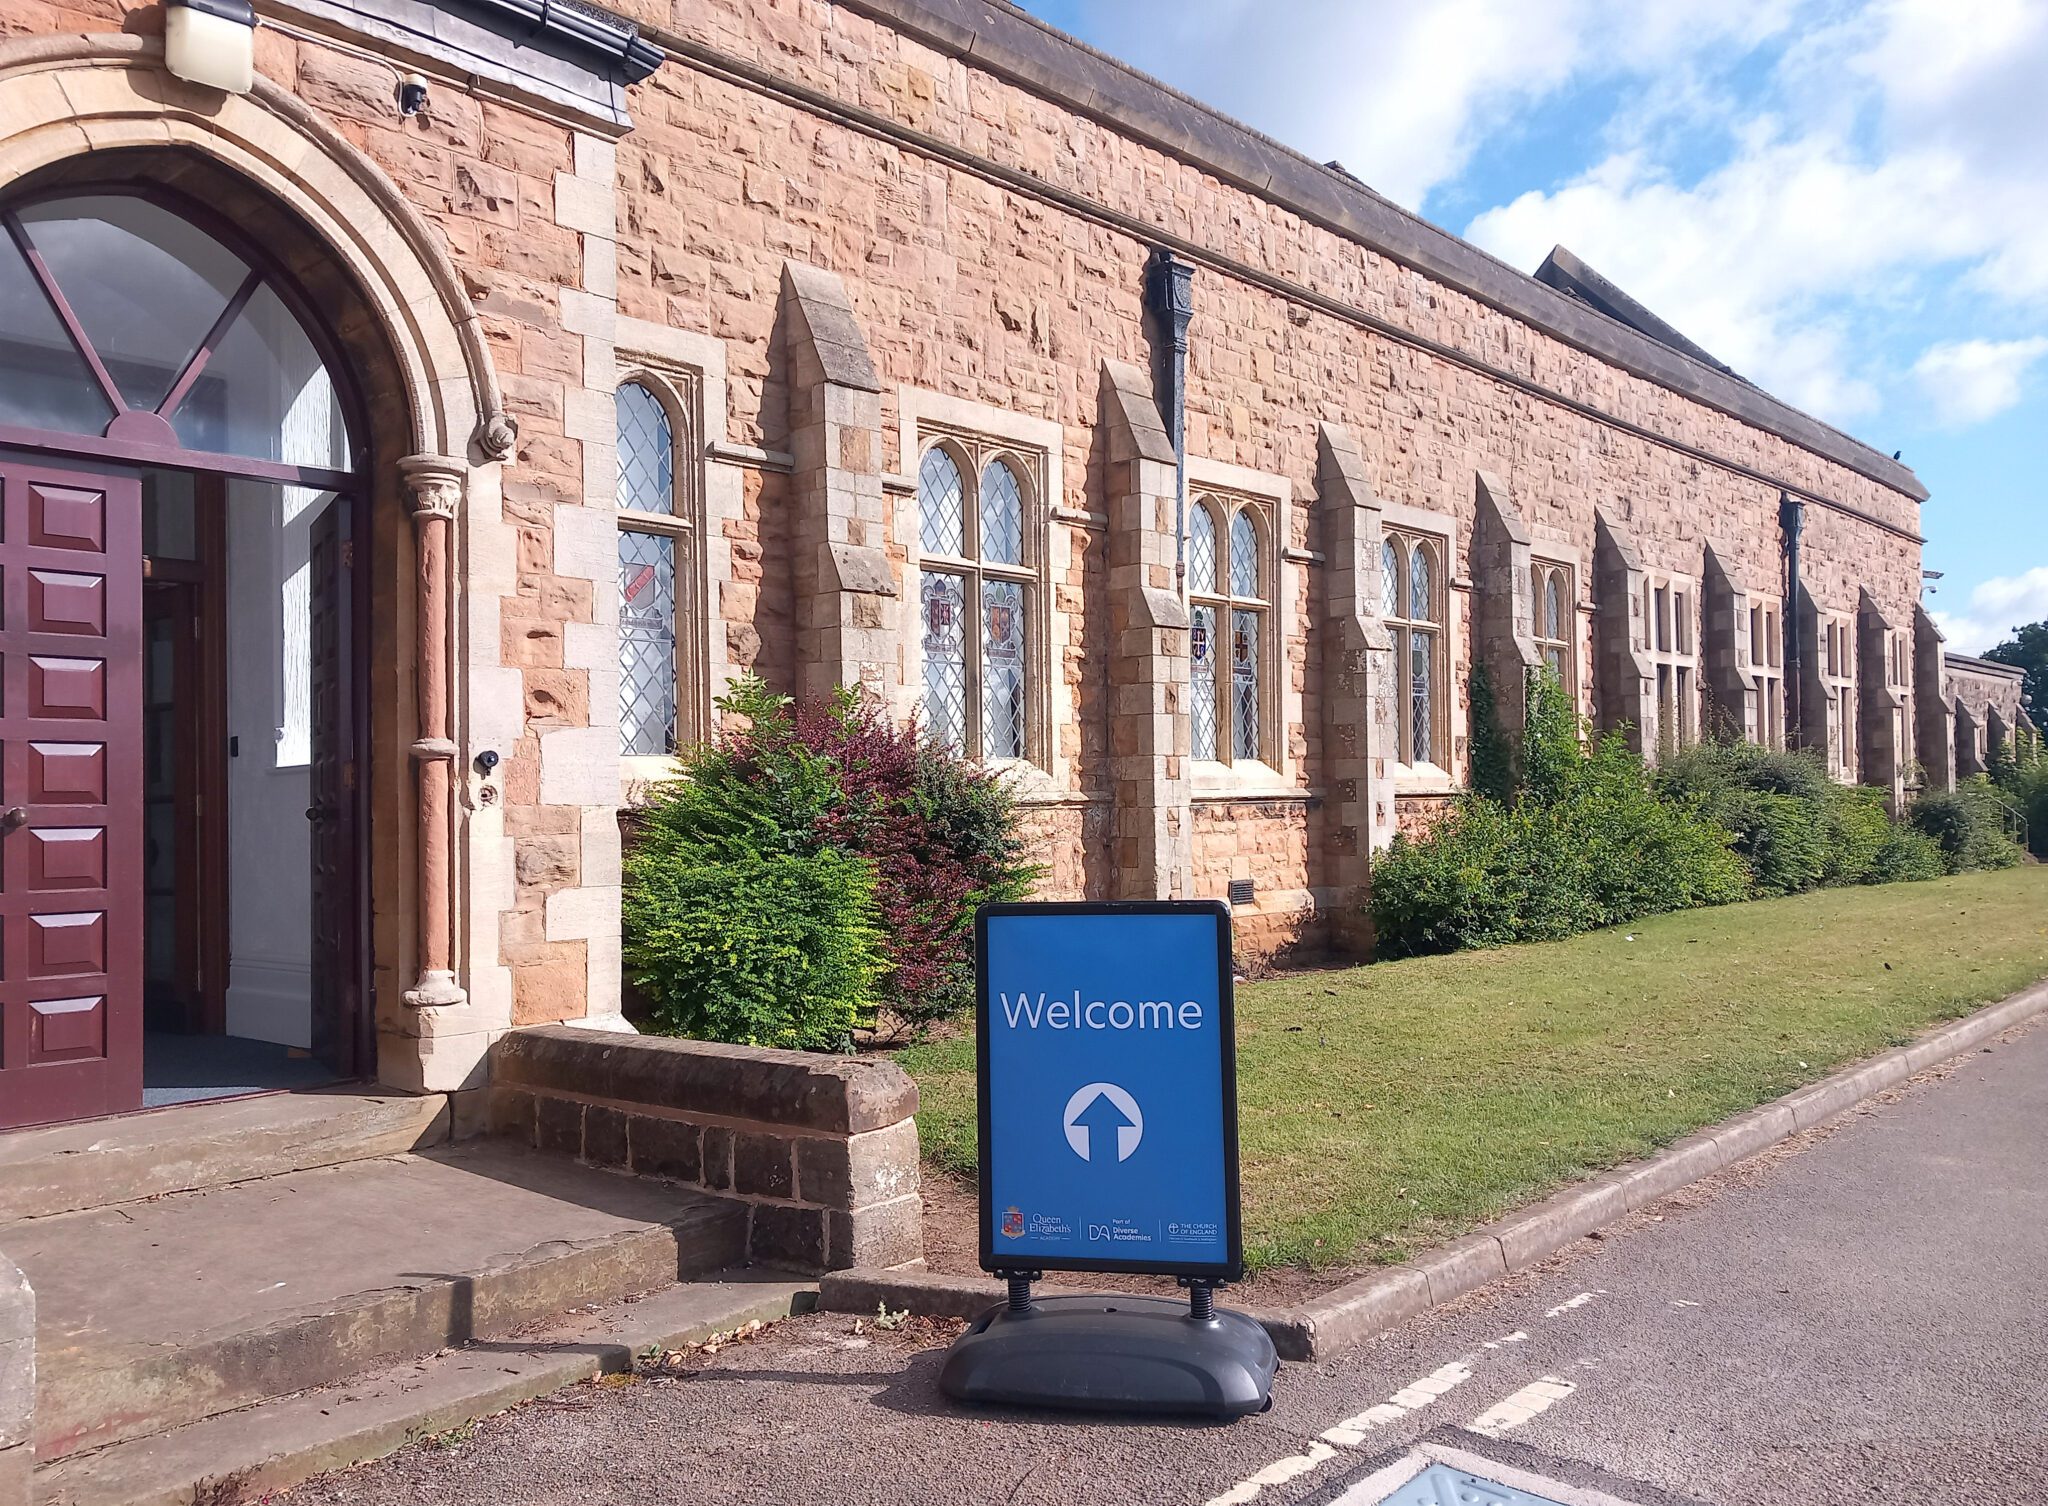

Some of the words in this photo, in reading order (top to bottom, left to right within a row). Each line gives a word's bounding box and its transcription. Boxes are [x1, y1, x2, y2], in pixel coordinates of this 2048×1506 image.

[1000, 990, 1203, 1029] Welcome
[1033, 1213, 1061, 1225] Queen
[1029, 1223, 1071, 1235] Elizabeth's
